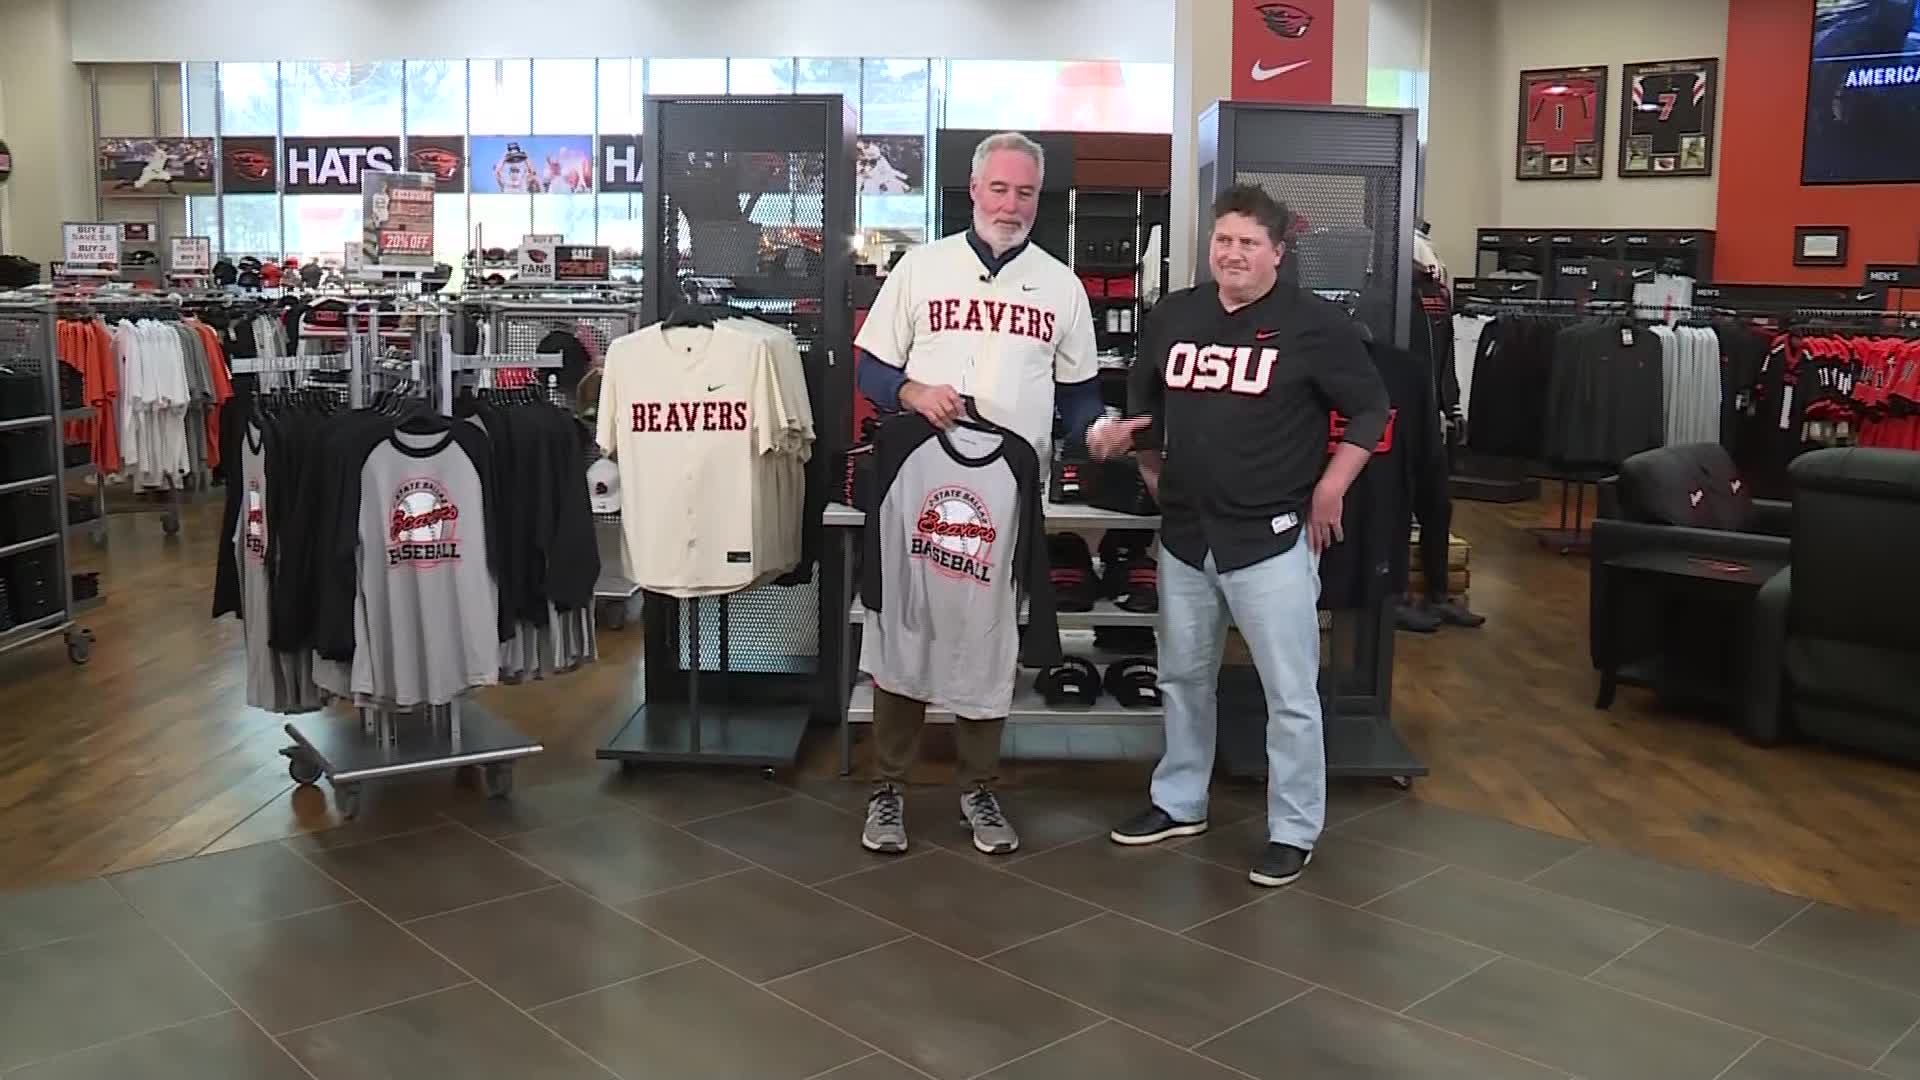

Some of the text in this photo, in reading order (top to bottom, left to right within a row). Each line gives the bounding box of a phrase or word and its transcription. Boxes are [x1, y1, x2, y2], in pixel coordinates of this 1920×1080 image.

[1555, 103, 1564, 130] 1
[1657, 92, 1677, 121] 7
[288, 146, 393, 185] HATS
[605, 146, 644, 183] H
[78, 244, 97, 252] BUY
[386, 233, 430, 249] 20% OFF
[521, 263, 552, 274] FANS
[1561, 265, 1589, 276] MEN'S
[1869, 271, 1900, 282] MEN'S
[1696, 288, 1721, 298] MEN'S
[927, 298, 1056, 344] BEAVERS
[1164, 340, 1280, 397] OSU
[631, 400, 748, 433] BEAVERS
[917, 509, 997, 544] Beavers
[910, 538, 991, 583] BASEBALL
